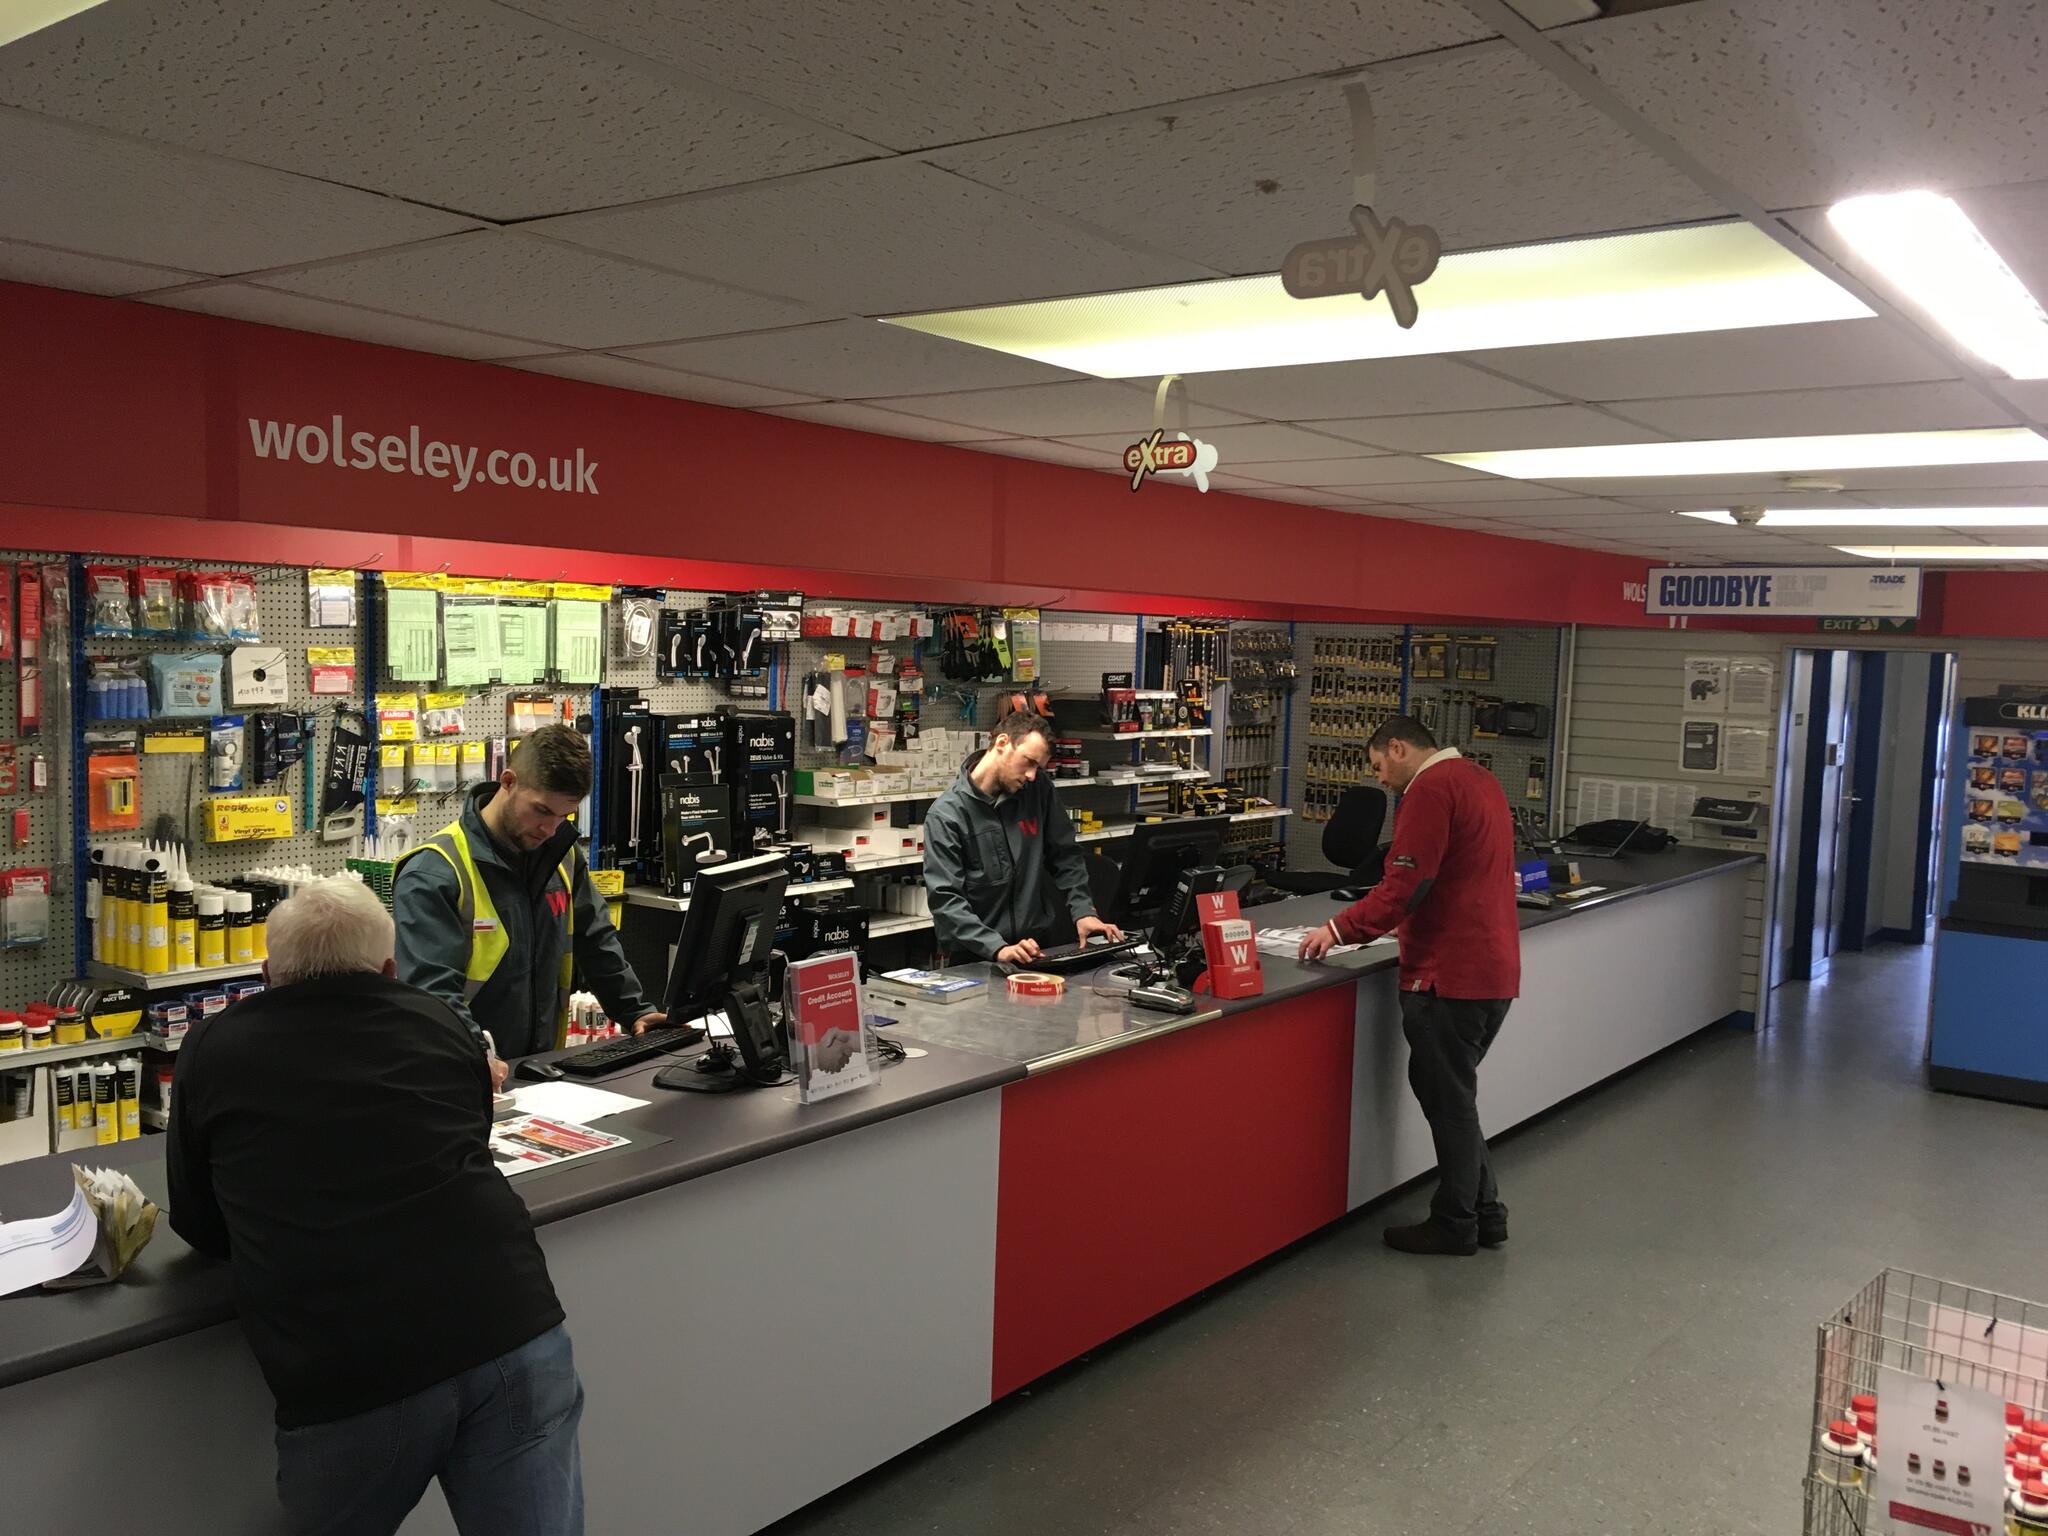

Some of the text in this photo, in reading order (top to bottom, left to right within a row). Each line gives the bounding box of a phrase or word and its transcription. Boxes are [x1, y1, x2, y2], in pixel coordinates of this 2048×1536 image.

[248, 415, 599, 494] wolseley.co.uk
[1872, 575, 1906, 585] TRADE
[1623, 581, 1647, 602] WOLS
[1660, 575, 1772, 607] GOODBYE
[1824, 619, 1853, 630] EXIT
[2017, 706, 2048, 719] KLI
[750, 732, 775, 747] nabis
[354, 745, 368, 791] ECLIPSE
[680, 793, 700, 805] nabis
[545, 889, 572, 917] W
[1211, 894, 1224, 910] W
[825, 926, 850, 942] nabis
[1230, 944, 1248, 965] W
[1009, 981, 1019, 993] W
[807, 988, 852, 1006] Credit Account
